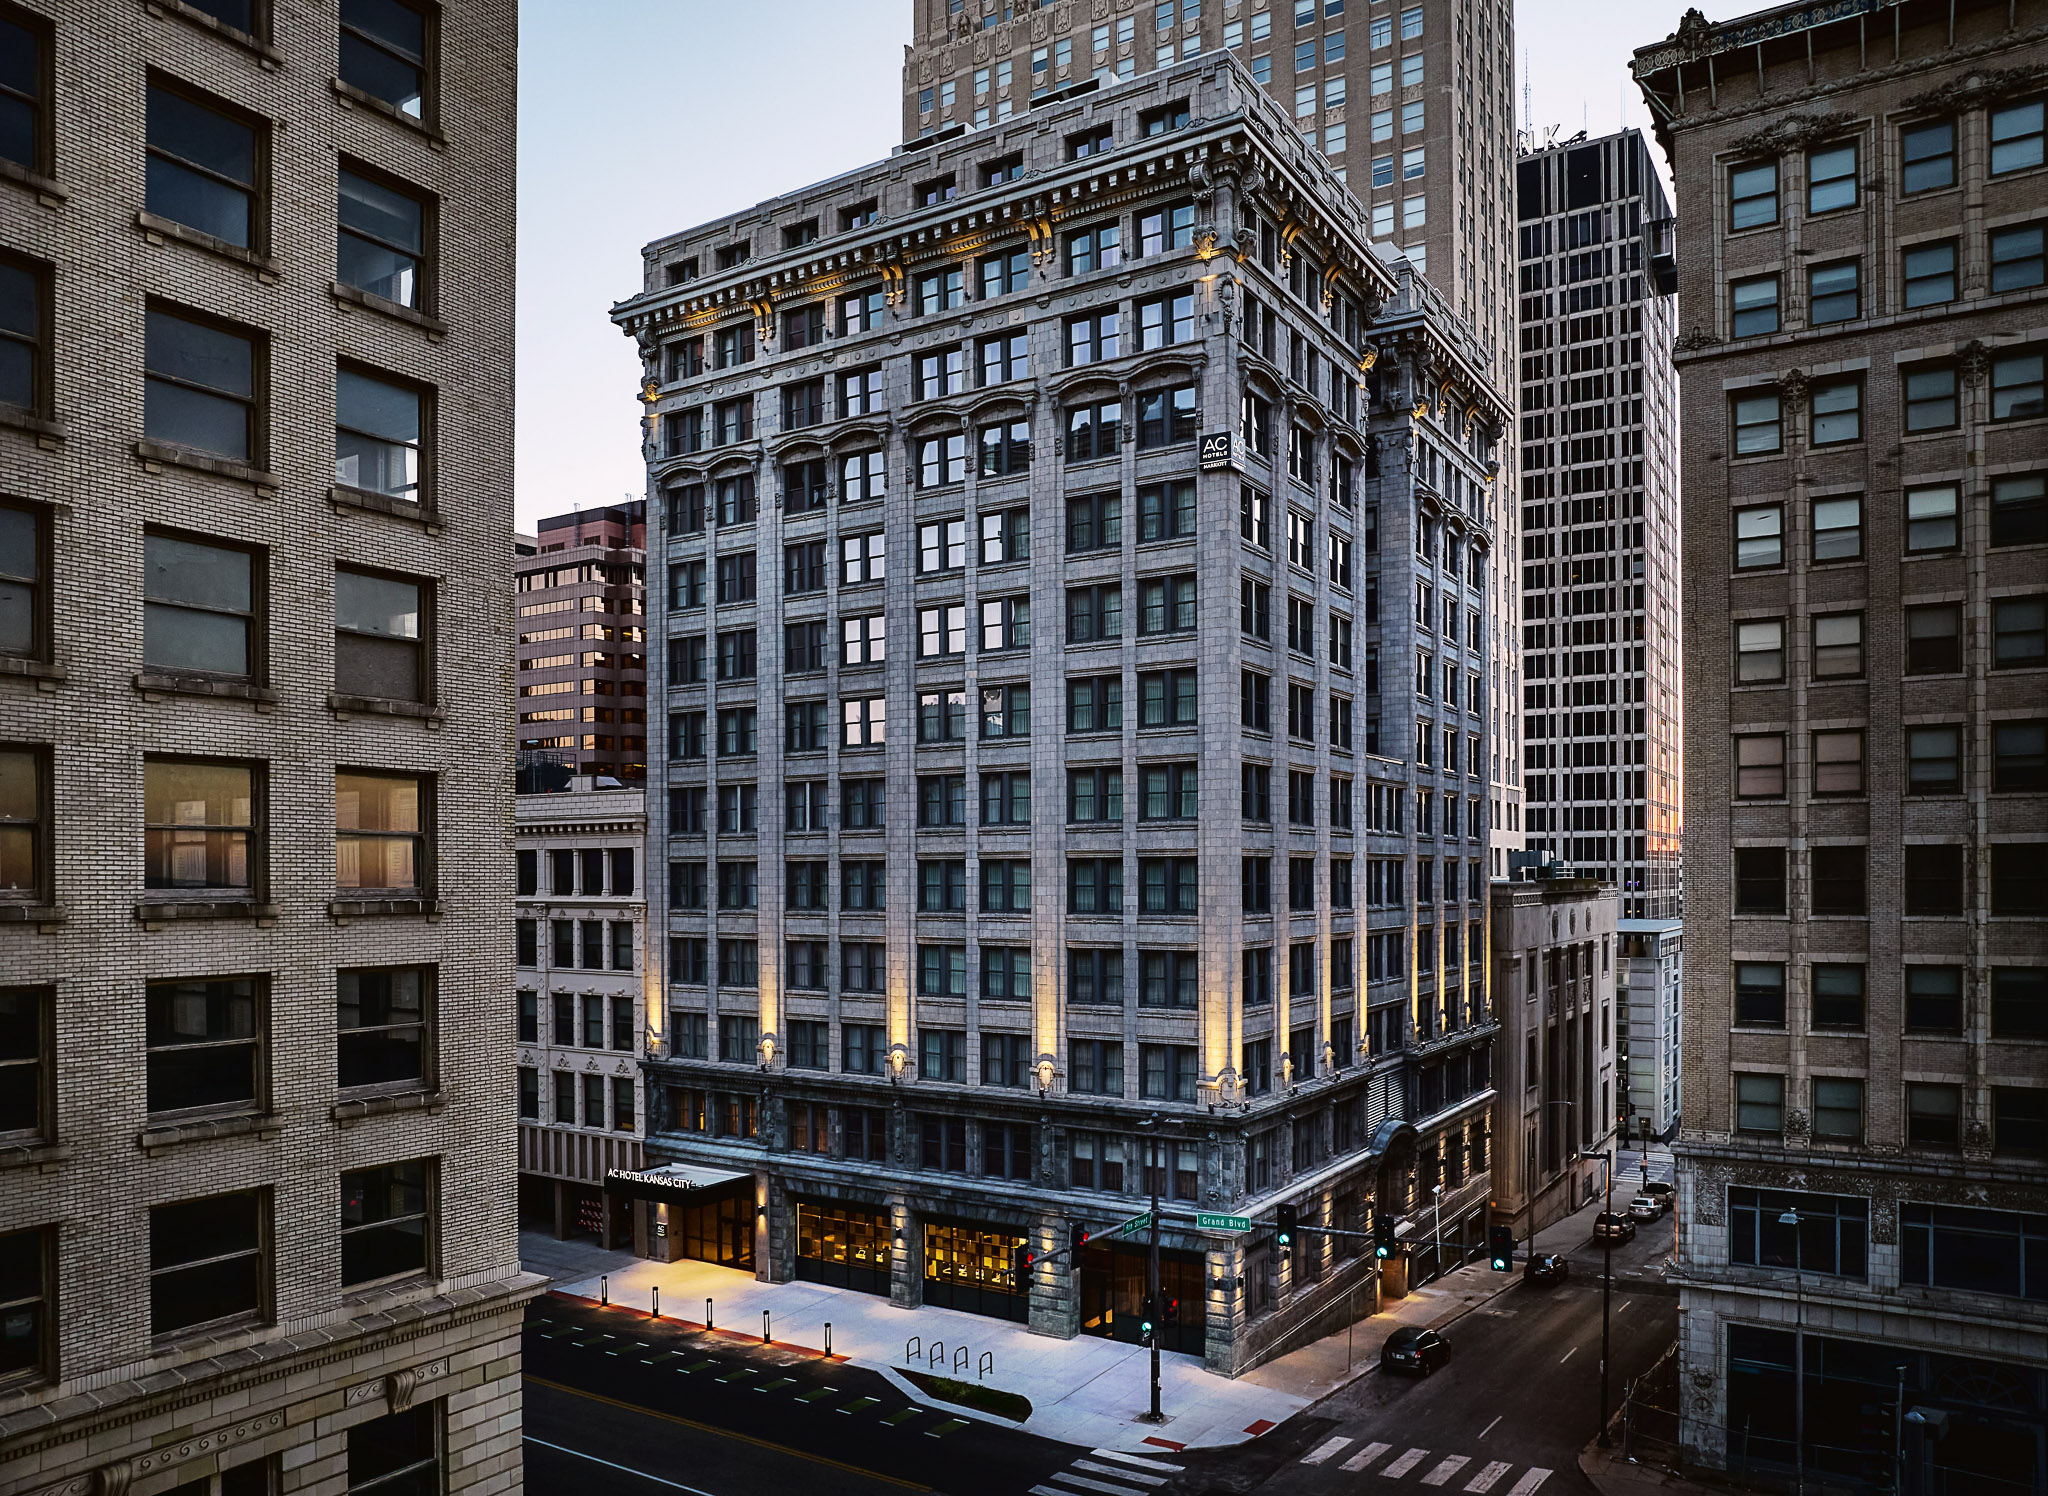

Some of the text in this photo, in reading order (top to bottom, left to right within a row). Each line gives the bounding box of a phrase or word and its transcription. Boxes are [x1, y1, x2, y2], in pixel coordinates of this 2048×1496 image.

[1203, 437, 1227, 453] AC
[1203, 451, 1227, 459] HOTELS
[1203, 461, 1227, 469] MARRIOTT
[608, 1168, 691, 1189] AC HOTEL KANSAS CITY
[1134, 1216, 1148, 1227] Street
[1202, 1217, 1246, 1229] Grand Blvd
